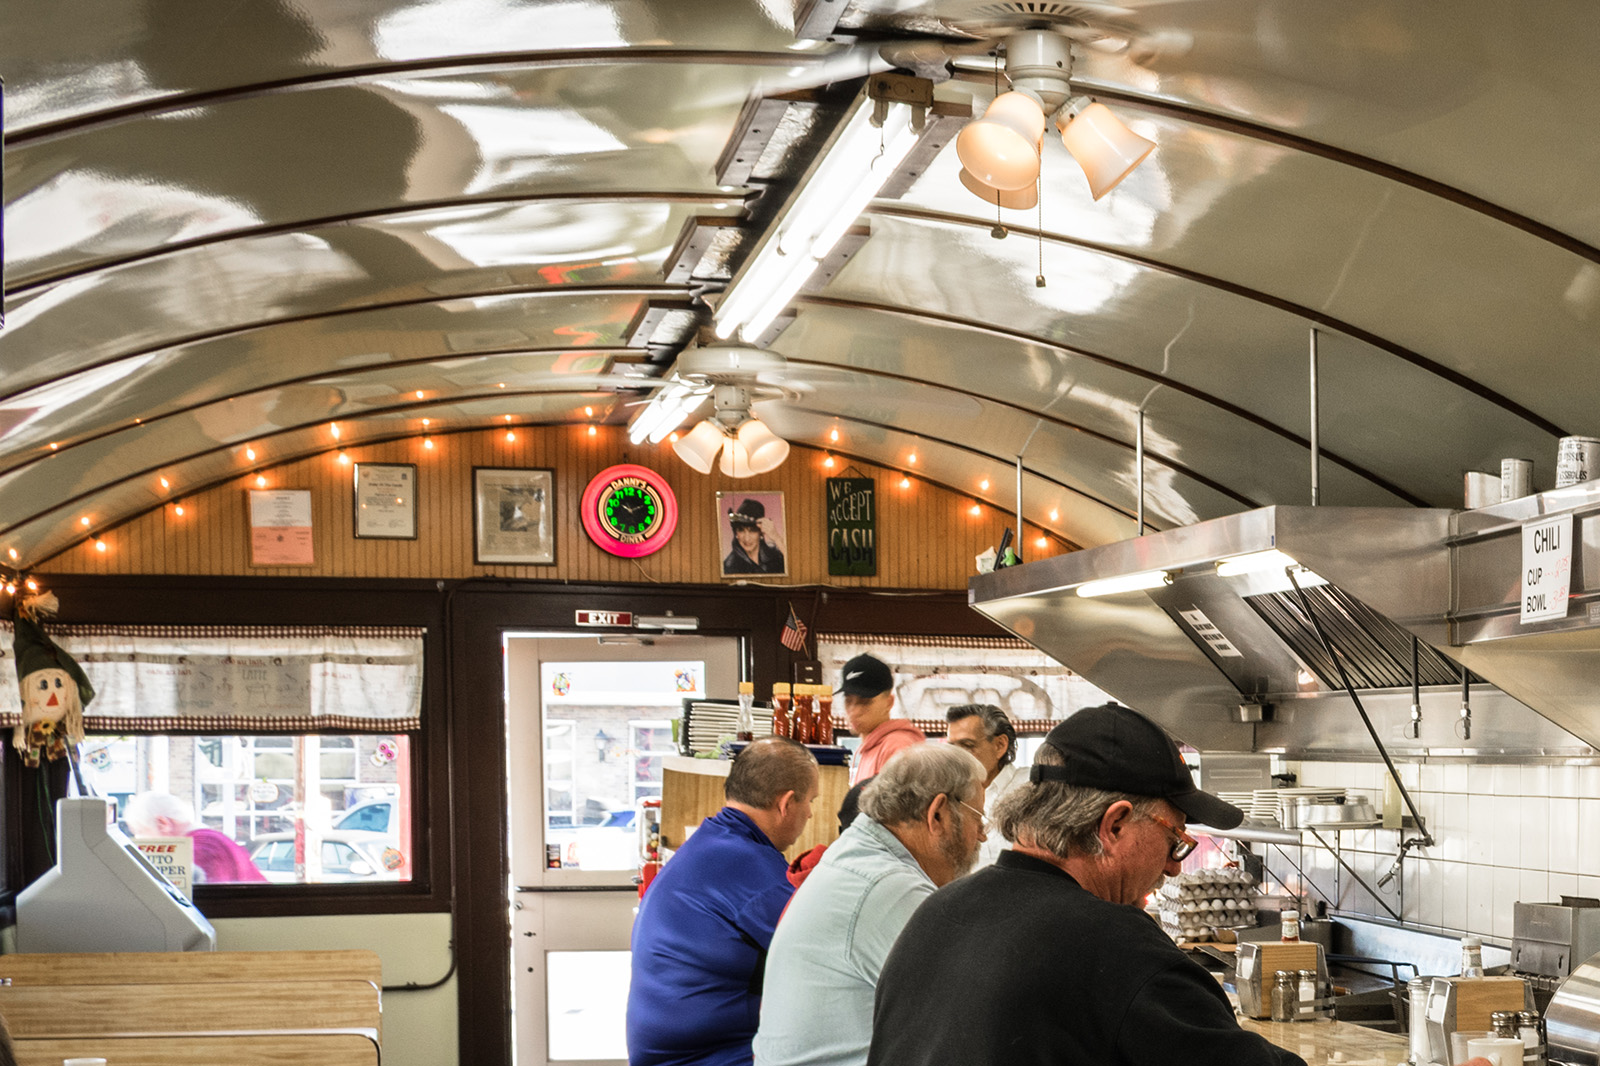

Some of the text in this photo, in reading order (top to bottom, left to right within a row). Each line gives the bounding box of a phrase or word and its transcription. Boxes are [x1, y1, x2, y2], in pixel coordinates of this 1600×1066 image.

[610, 477, 647, 491] DANNY'S
[829, 481, 852, 501] WE
[614, 488, 643, 500] 11 1
[623, 486, 635, 497] 12
[608, 494, 651, 508] 10 2
[829, 490, 872, 525] ACCEPT
[606, 505, 655, 517] 9 3
[619, 522, 645, 532] 7 5
[644, 515, 652, 525] 4
[628, 525, 635, 534] 6
[830, 527, 873, 566] CASH
[1534, 525, 1560, 554] CHILI
[1527, 567, 1543, 586] CUP
[1526, 593, 1547, 613] BOWL
[588, 611, 620, 625] EXIT
